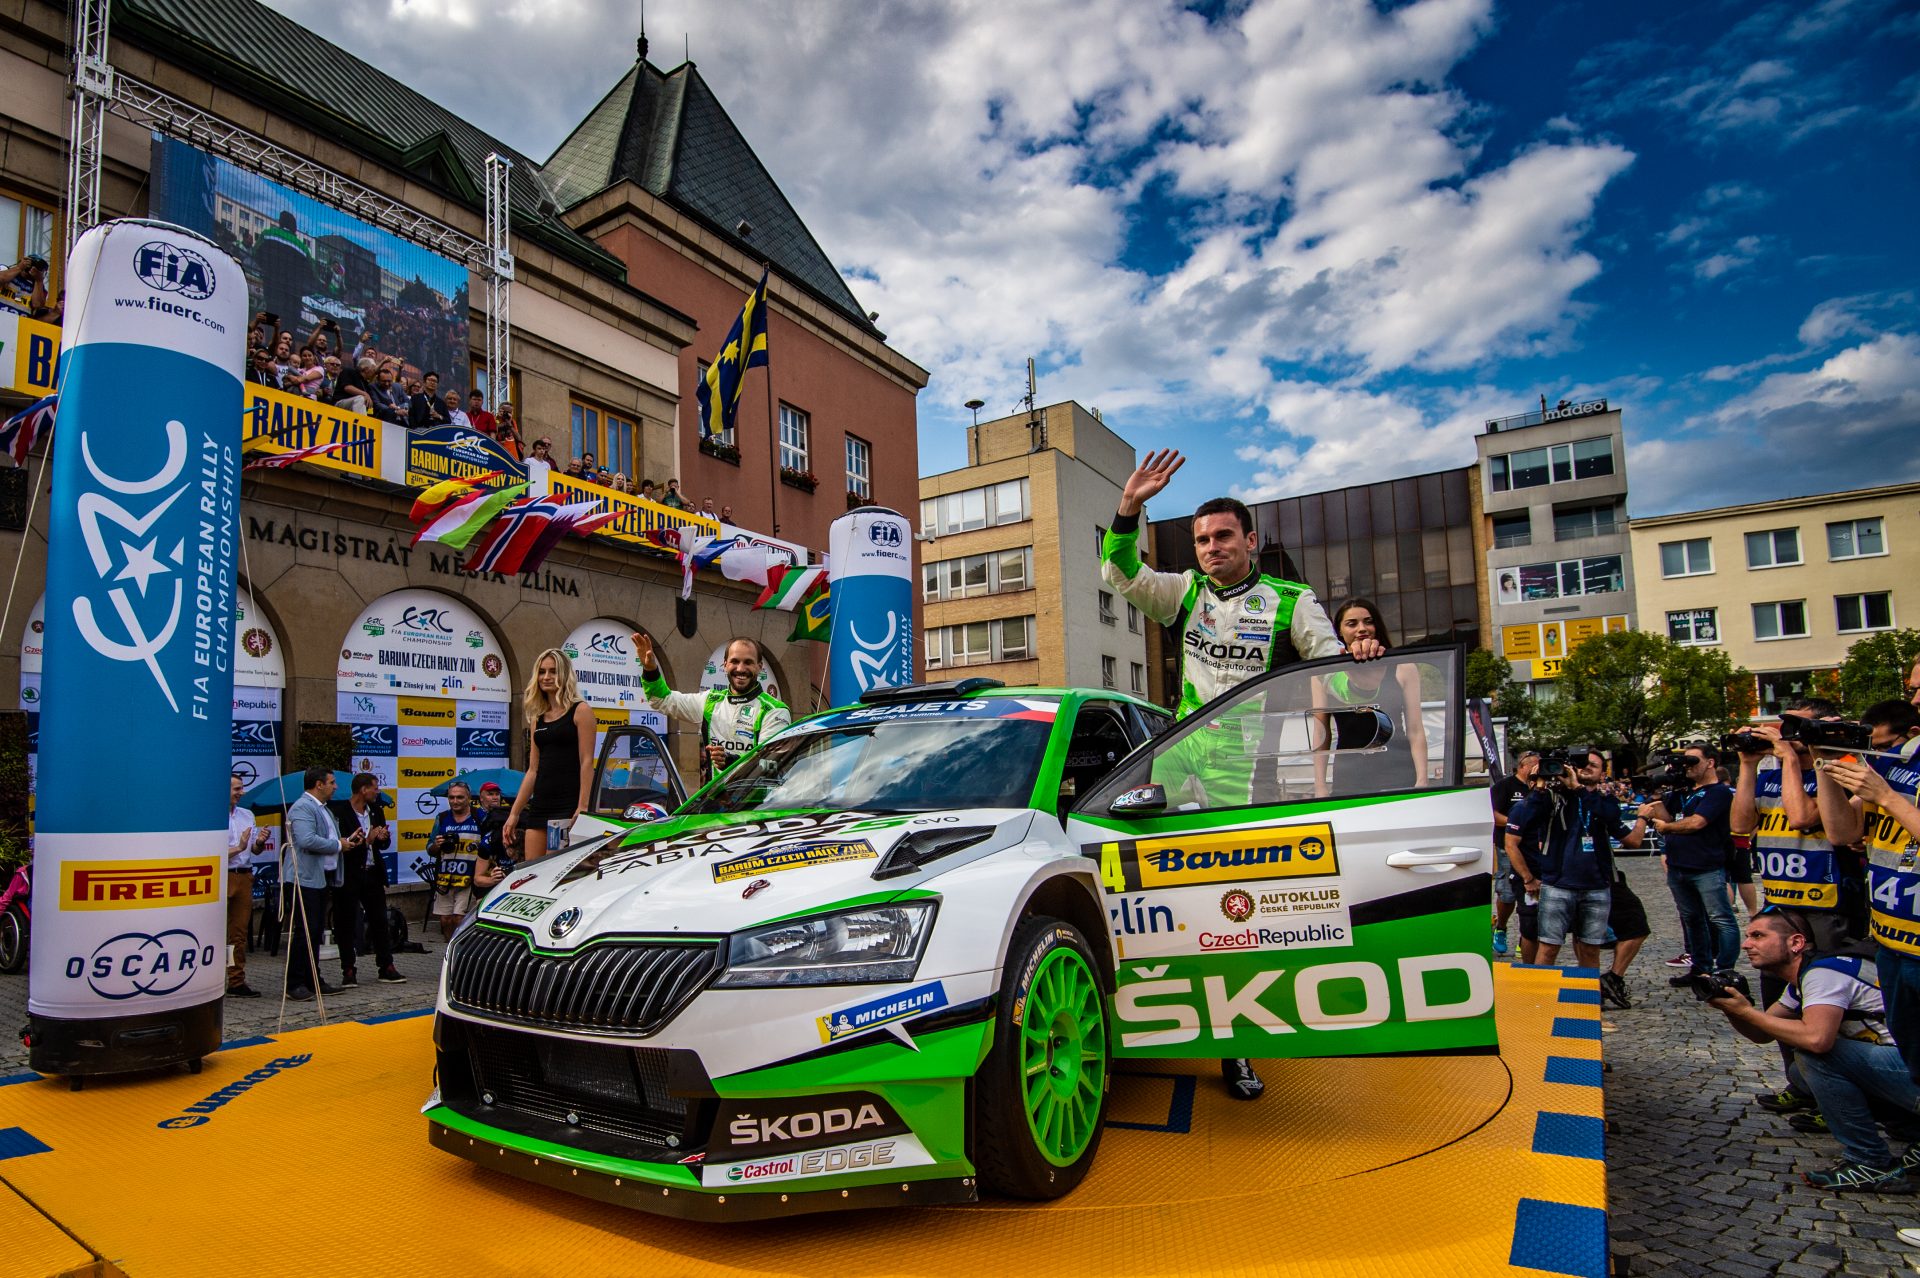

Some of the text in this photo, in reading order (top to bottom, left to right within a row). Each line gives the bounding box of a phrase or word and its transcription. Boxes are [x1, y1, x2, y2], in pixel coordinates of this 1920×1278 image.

[114, 296, 225, 334] www.fiaerc.com
[1544, 401, 1604, 421] madeo
[252, 395, 376, 469] RALLY ZLÍN
[411, 447, 449, 475] BARUM
[450, 458, 480, 480] CZECH
[613, 499, 654, 538] CZECH
[215, 445, 233, 673] CHAMPIONSHIP
[249, 516, 413, 567] MAGISTRÁT
[521, 570, 580, 597] ZLÍNA
[193, 431, 219, 721] FIA EUROPEAN RALLY
[1222, 583, 1249, 597] ŠKODA
[1238, 617, 1268, 625] ŠKODA
[402, 636, 453, 647] CHAMPIONSHIP
[403, 630, 435, 639] EUROPEAN
[1184, 629, 1265, 661] ŠKODA
[378, 649, 410, 667] BARUM
[411, 653, 436, 670] CZECH
[437, 655, 459, 672] RALLY
[459, 656, 475, 673] ZLÍN
[1184, 649, 1264, 672] www.skoda-auto.com
[575, 669, 597, 684] BARUM
[598, 671, 616, 686] CZECH
[616, 673, 631, 687] RALLY
[232, 699, 277, 710] hRepublic
[400, 707, 446, 718] Barum
[846, 700, 989, 720] SEAJETS
[402, 737, 453, 747] CzechRepublic
[401, 768, 445, 777] Barum
[401, 831, 430, 840] Bar
[597, 843, 735, 881] FABIA
[912, 816, 961, 826] evo
[441, 861, 468, 875] 180
[718, 858, 765, 875] BARUM
[767, 853, 805, 865] CZECH
[807, 847, 839, 859] RALLY
[1144, 844, 1292, 872] Barum
[72, 864, 213, 901] PIRELLI
[1259, 889, 1341, 905] AUTOKLUB
[1260, 901, 1341, 914] ČESKÉ REPUBLIKY
[1198, 924, 1345, 949] CzechRepublic
[65, 944, 215, 979] OSCARO
[1021, 931, 1054, 991] MICHELIN
[855, 991, 935, 1025] MICHELIN
[1115, 952, 1494, 1048] ŠKOD
[730, 1104, 885, 1145] ŠKODA
[743, 1141, 896, 1179] Castrol EDGE
